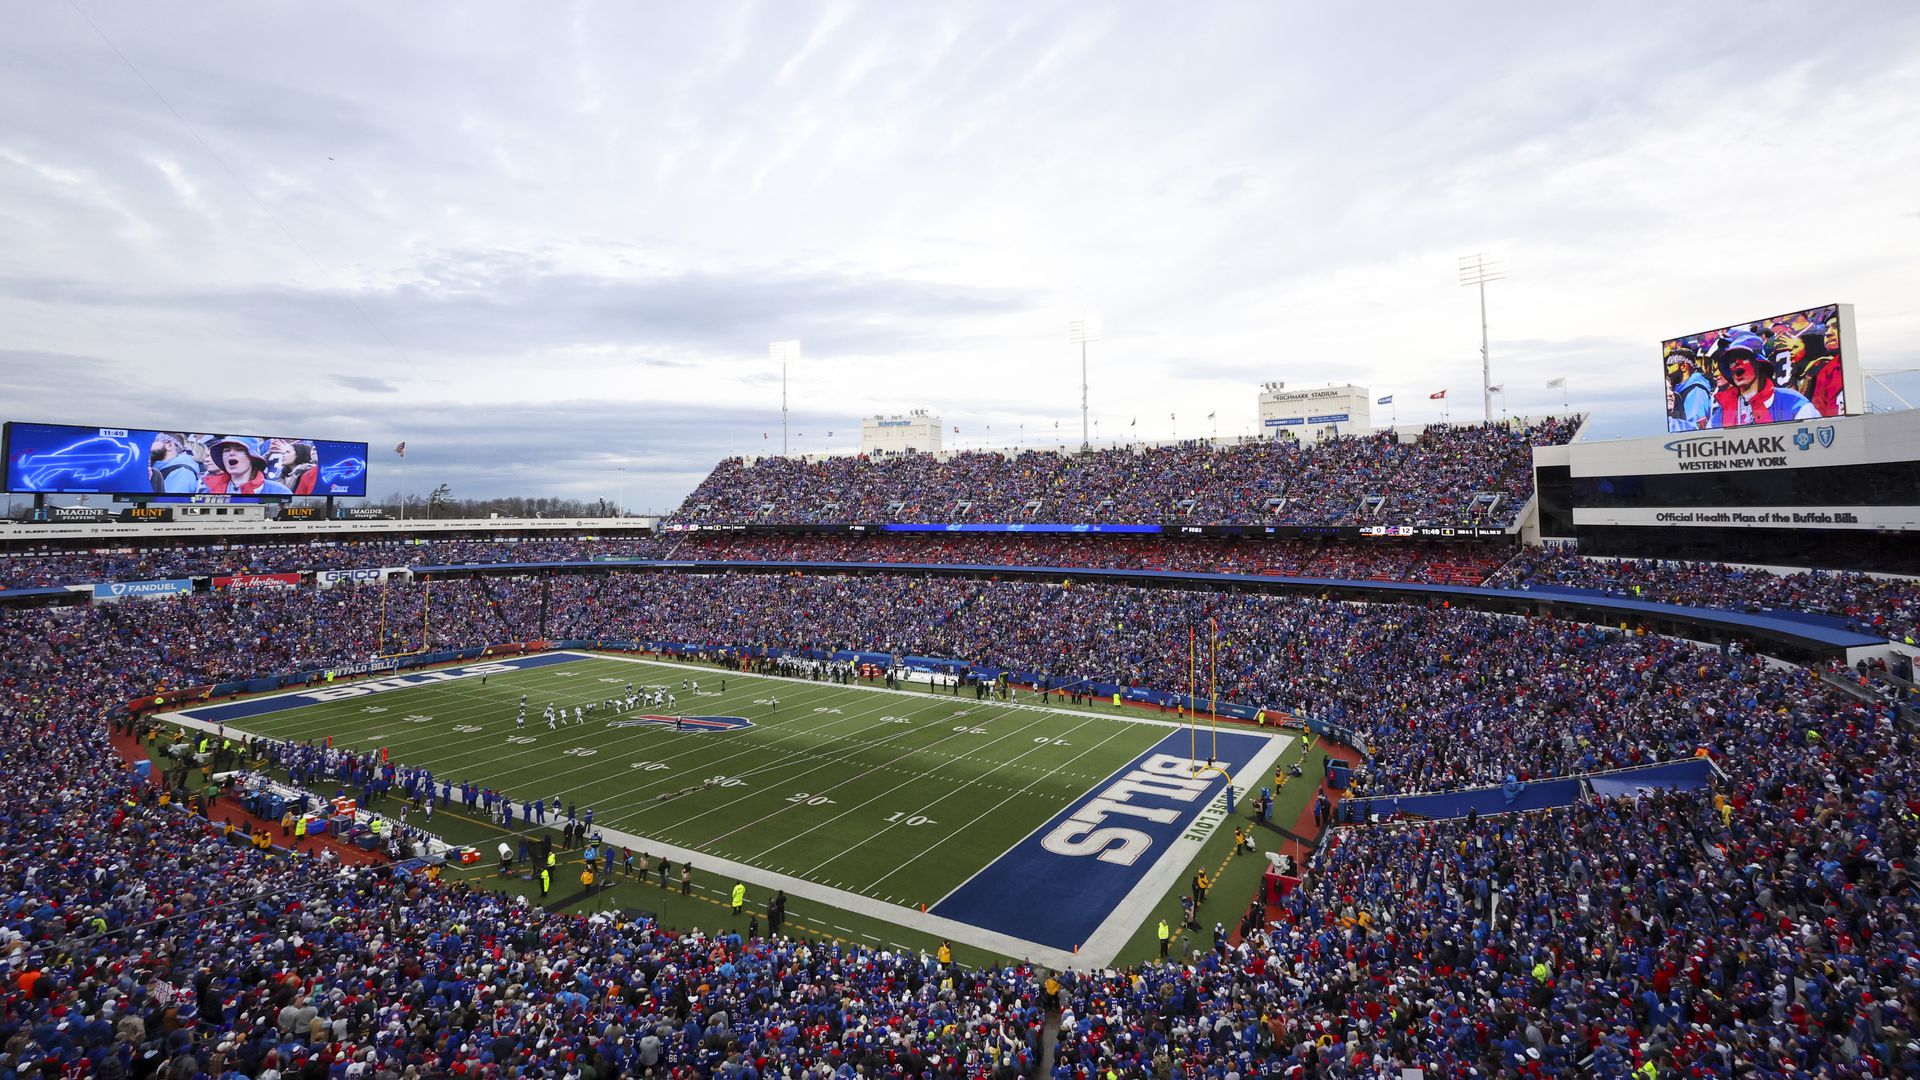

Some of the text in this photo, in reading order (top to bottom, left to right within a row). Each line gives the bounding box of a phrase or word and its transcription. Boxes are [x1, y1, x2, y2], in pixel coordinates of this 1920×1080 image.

[1277, 393, 1308, 401] HIGHMARK
[1677, 436, 1786, 458] HIGHMARK
[1679, 456, 1787, 470] WESTERN NEW YORK
[131, 508, 163, 516] HUNT
[288, 508, 313, 516] HUNT
[1656, 513, 1858, 523] Official Health Plan of the Buffalo Bills
[326, 569, 380, 582] GEICO
[128, 582, 177, 593] FANDUEL
[323, 665, 367, 678] BUFFALO
[297, 664, 521, 701] BILLS
[785, 792, 829, 806] 20
[1040, 753, 1231, 867] BILLS
[883, 811, 930, 826] 10
[1184, 816, 1219, 841] LOVE
[66, 1067, 82, 1080] 17
